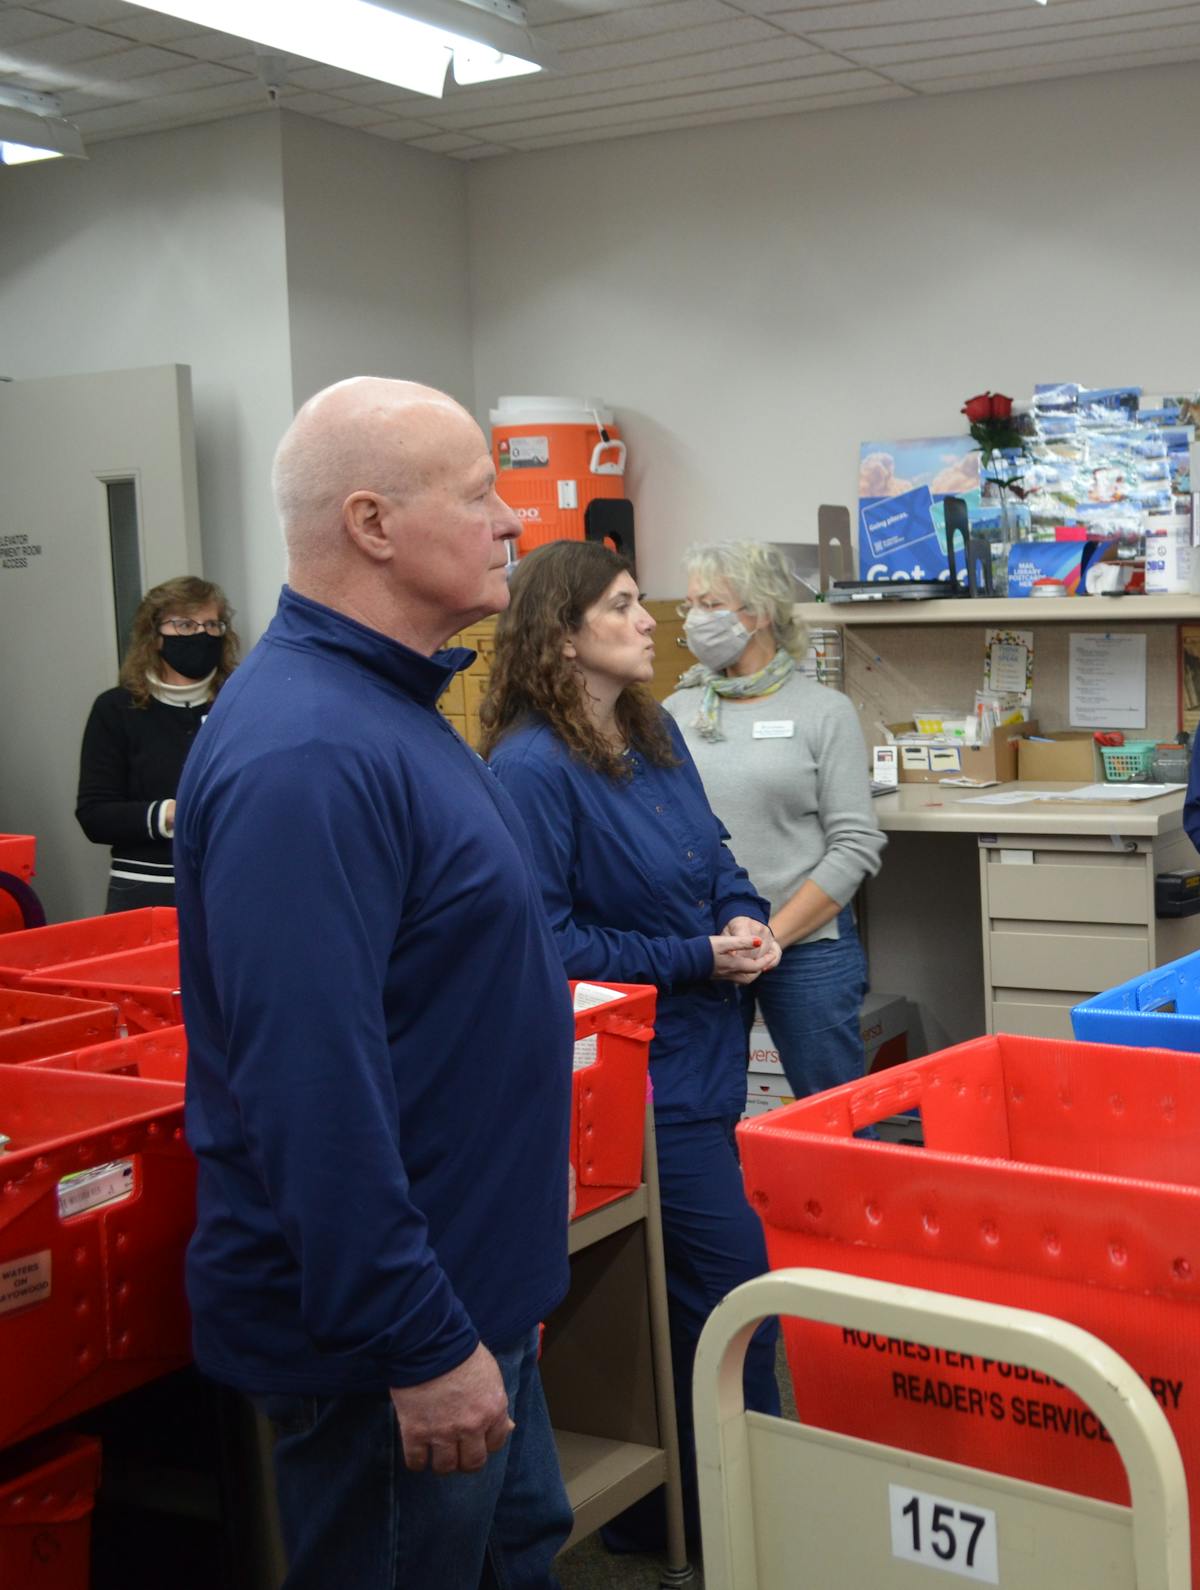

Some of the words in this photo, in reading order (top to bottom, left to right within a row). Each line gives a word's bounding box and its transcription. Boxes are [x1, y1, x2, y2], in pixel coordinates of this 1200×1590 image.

[749, 1048, 780, 1063] vers
[2, 1262, 39, 1280] WATERS
[0, 1281, 49, 1300] AYOWOOD
[14, 1276, 28, 1288] ON
[892, 1371, 1006, 1421] READER'S
[1010, 1396, 1113, 1444] SERVIC
[902, 1496, 986, 1568] 157
